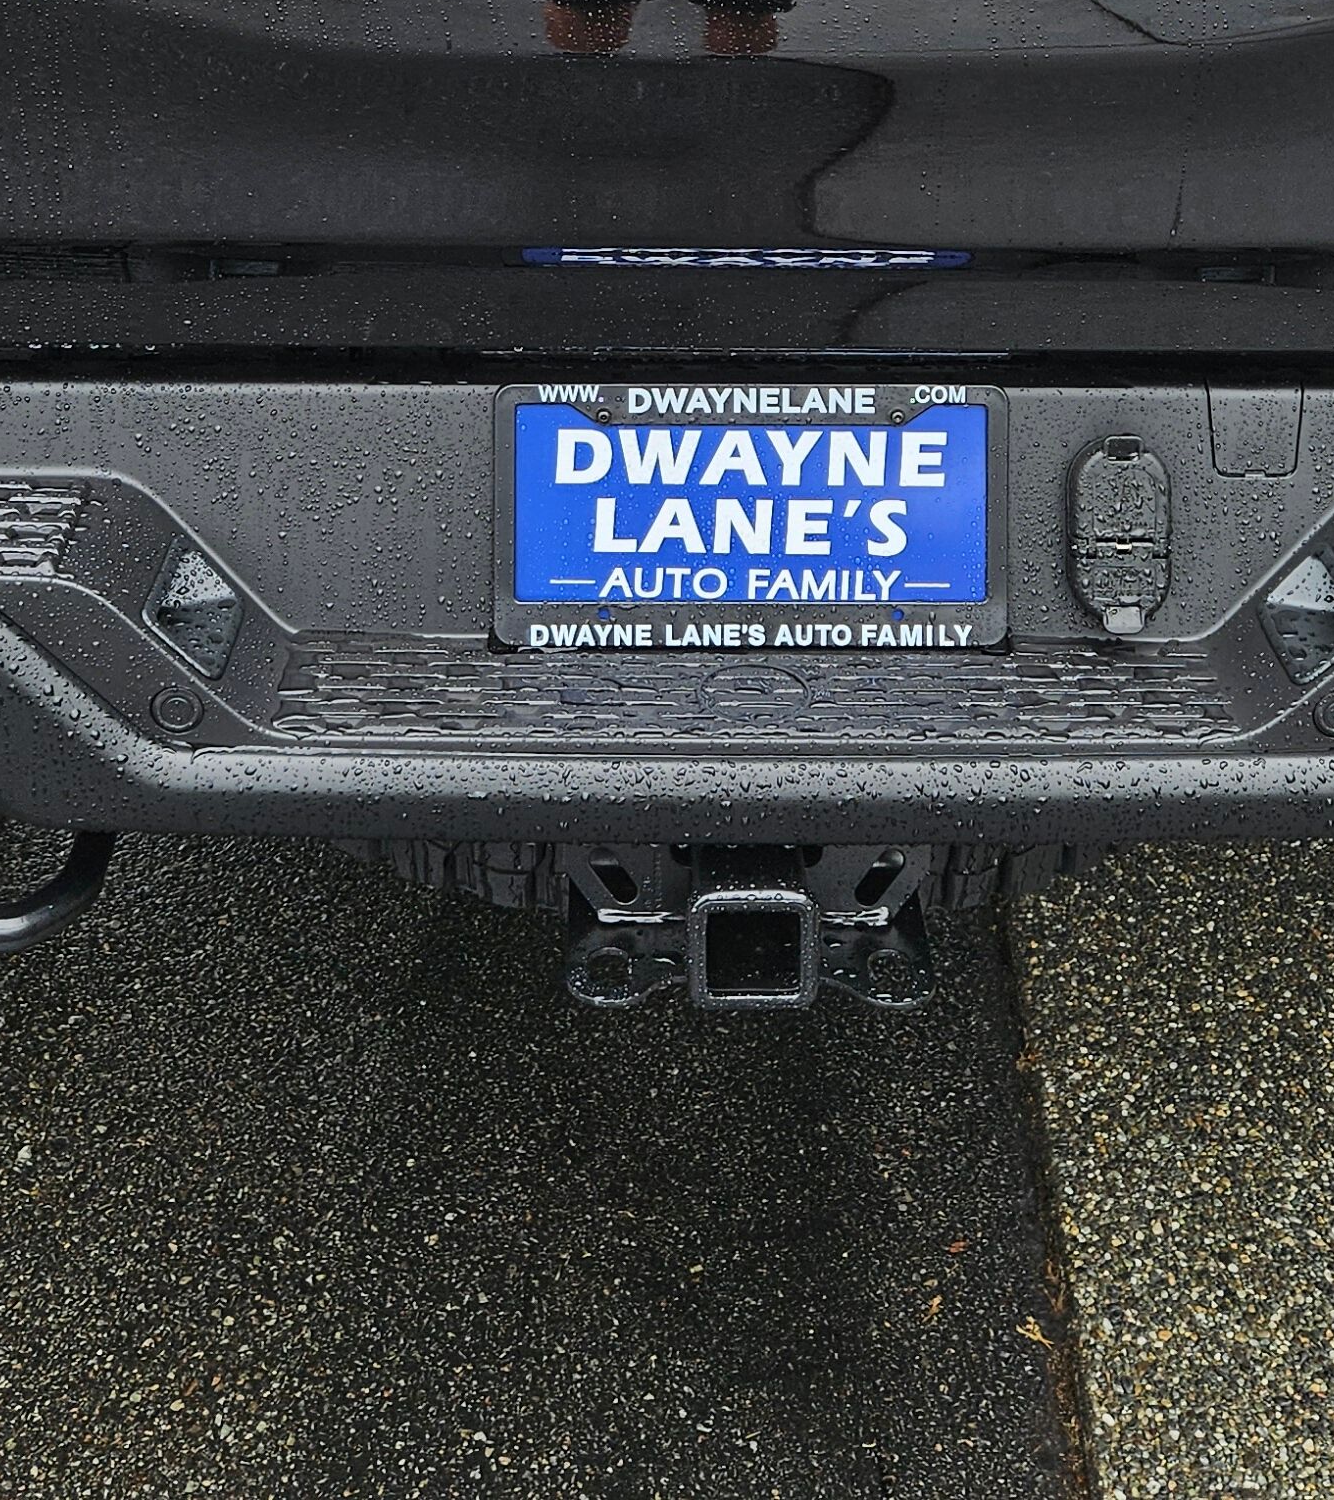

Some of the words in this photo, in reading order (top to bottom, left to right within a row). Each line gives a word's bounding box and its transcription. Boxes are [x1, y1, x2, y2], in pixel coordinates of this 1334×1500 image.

[538, 384, 605, 403] WWW.
[627, 387, 876, 415] DWAYNELANE
[554, 428, 948, 488] DWAYNE
[593, 497, 908, 557] LANE'S
[598, 567, 728, 599] AUTO
[747, 568, 902, 601] FAMILY
[529, 623, 653, 647] DWAYNE
[665, 623, 766, 648] LANE'S
[773, 624, 853, 647] AUTO
[861, 624, 973, 647] FAMILY
